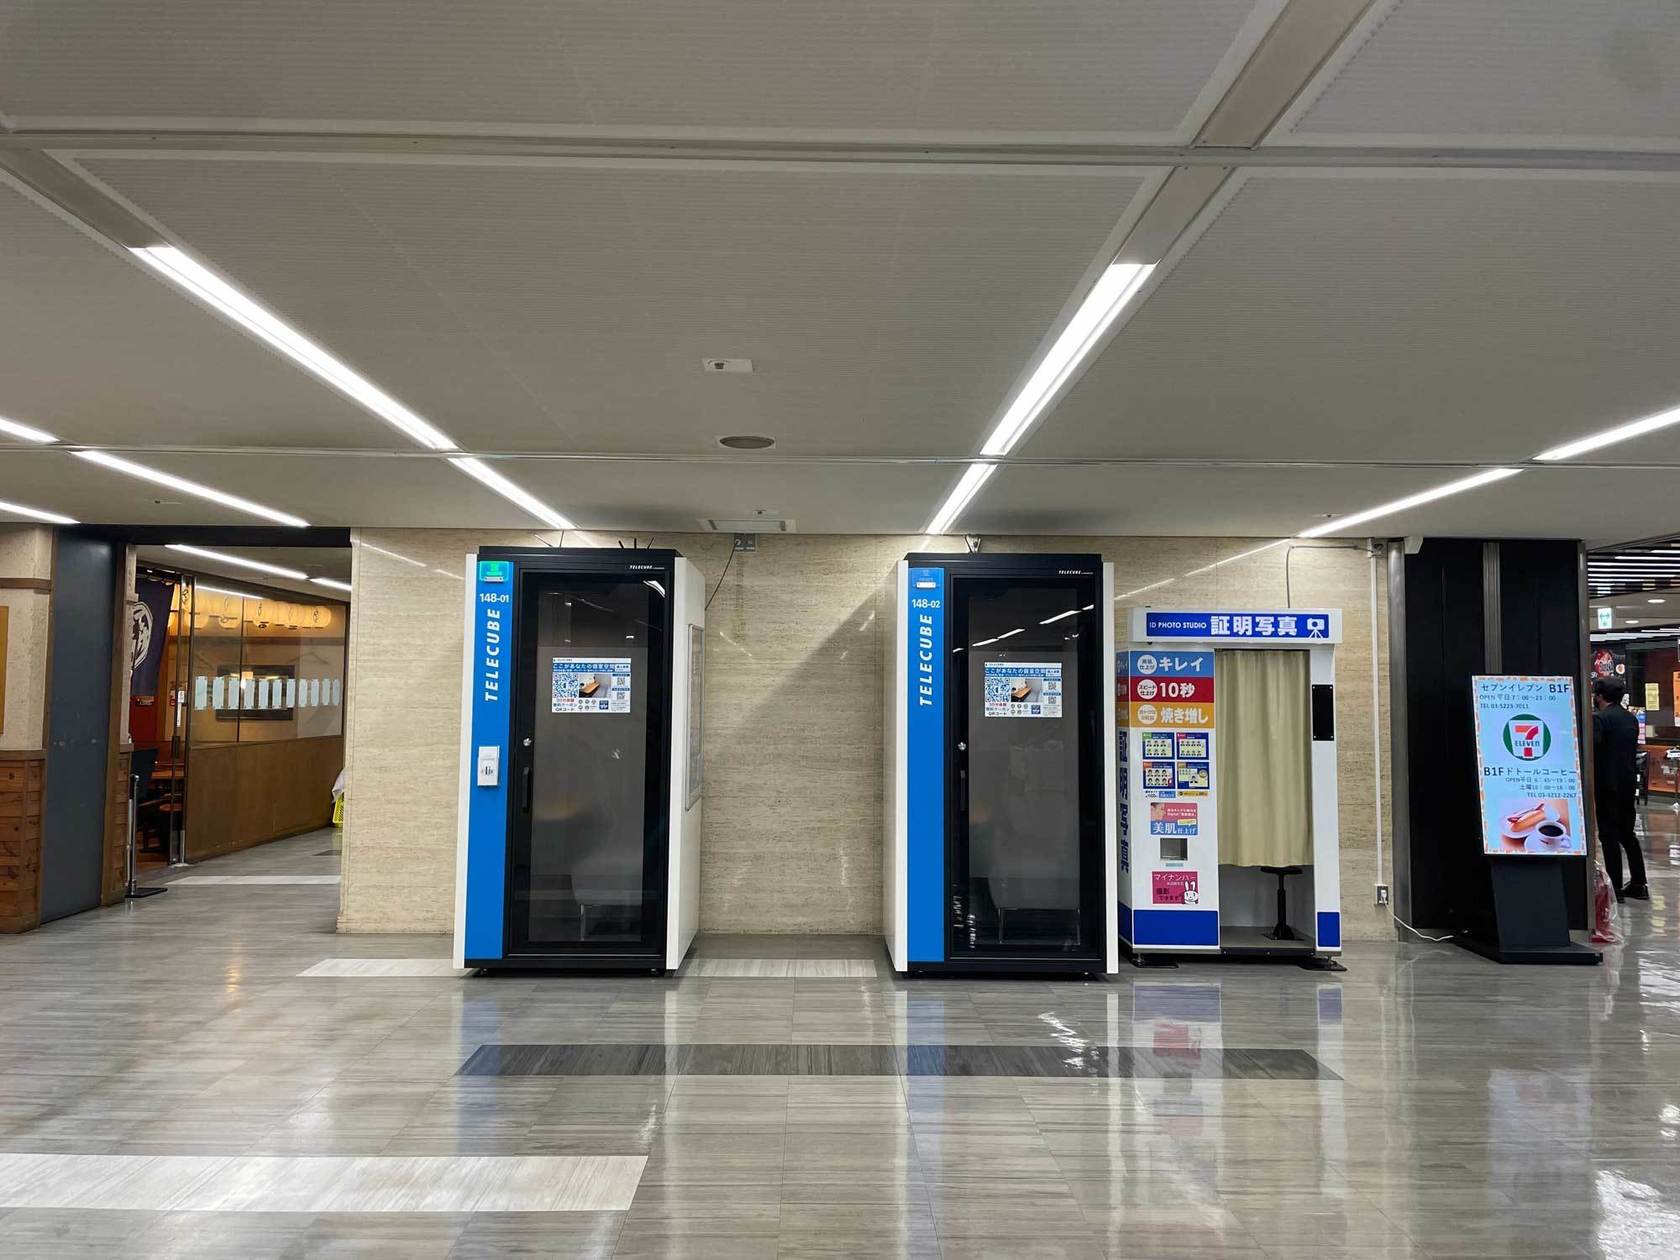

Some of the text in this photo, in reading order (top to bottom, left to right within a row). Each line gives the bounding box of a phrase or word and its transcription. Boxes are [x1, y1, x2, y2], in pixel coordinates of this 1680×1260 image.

[480, 593, 509, 603] 148-01
[912, 598, 941, 609] 148-02
[1149, 621, 1207, 630] ID PHOTO STUDIO
[1210, 615, 1298, 636] 証明写真
[485, 609, 501, 702] TELECUBE
[919, 614, 933, 706] TELECUBE
[1159, 656, 1204, 672] キレイ
[1159, 682, 1195, 698] 10秒
[1549, 683, 1570, 693] B1F
[1161, 706, 1209, 724] 焼き増し
[1483, 766, 1577, 777] B1F ドトールコーヒー
